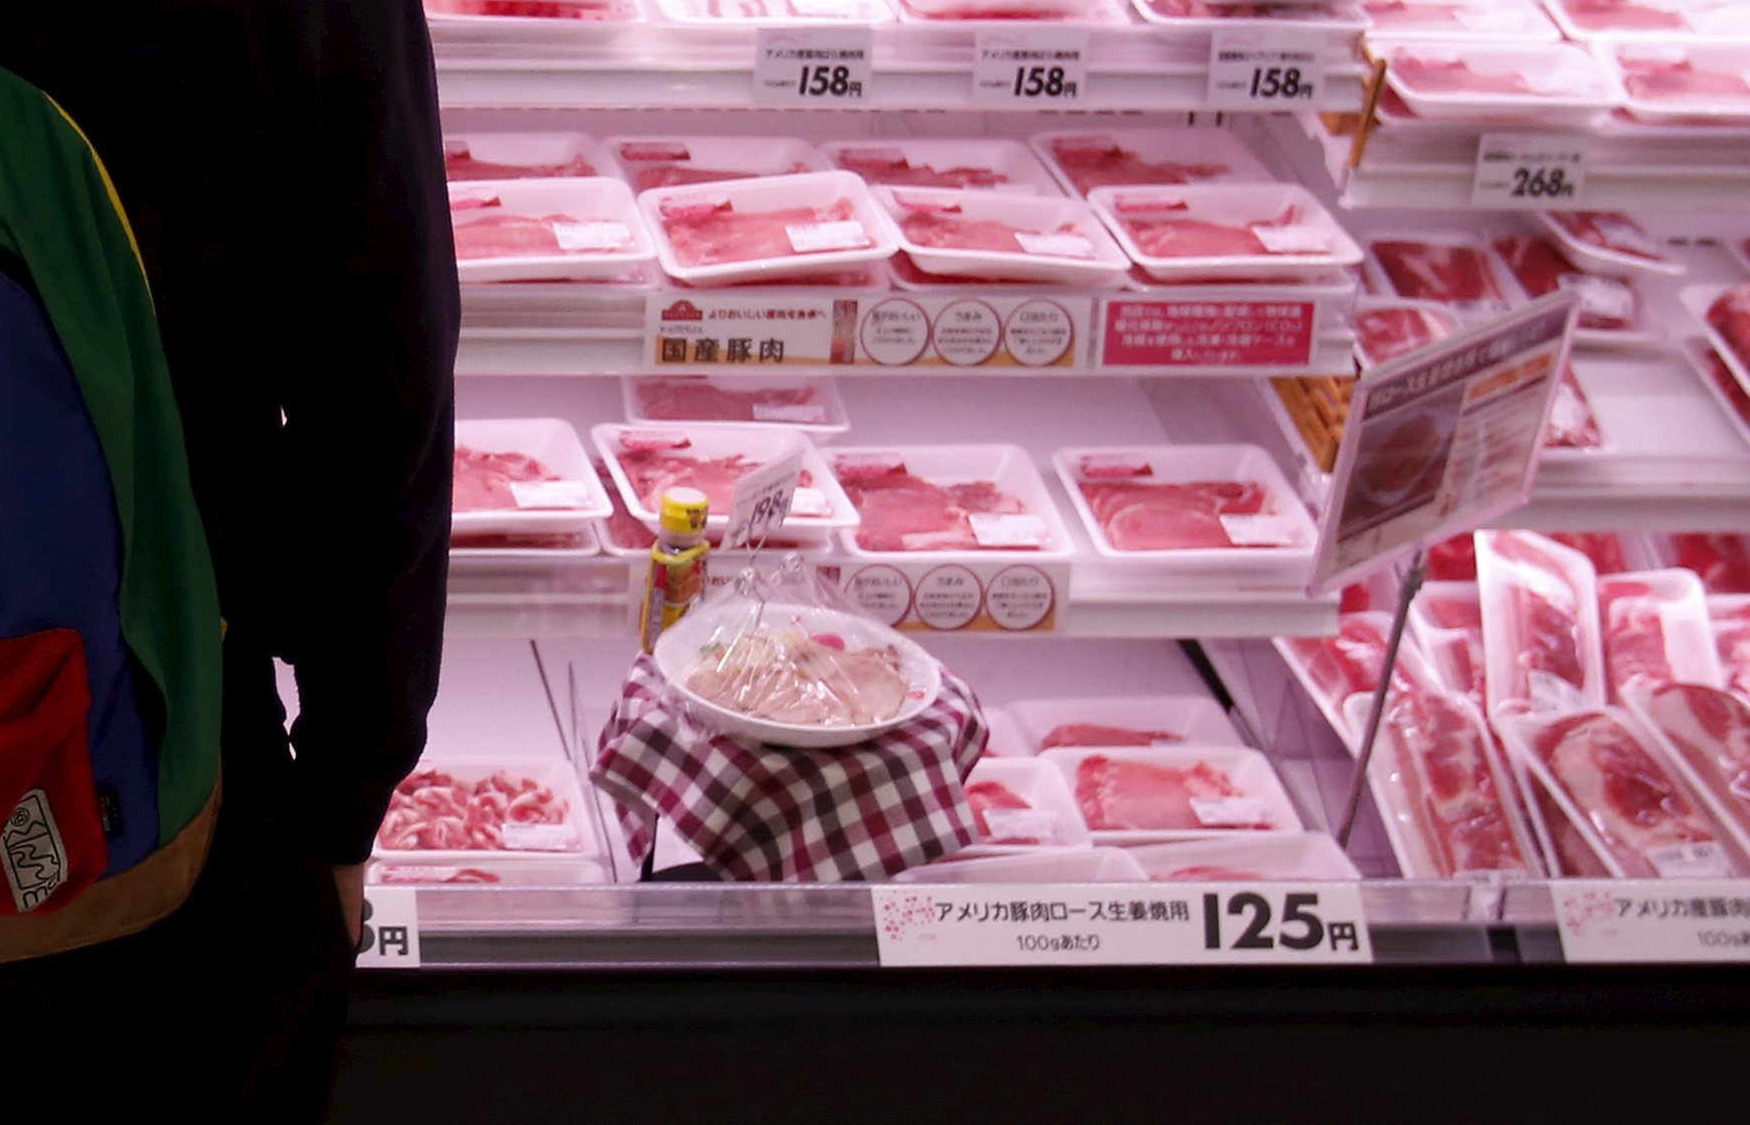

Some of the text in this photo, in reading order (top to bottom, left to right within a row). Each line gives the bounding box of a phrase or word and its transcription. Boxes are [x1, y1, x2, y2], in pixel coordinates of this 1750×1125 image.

[798, 65, 862, 98] 158円
[1014, 66, 1078, 99] 158円
[1250, 67, 1313, 100] 158円
[662, 338, 786, 363] 国産豚肉
[935, 900, 1189, 922] アメリカ豚肉ロース生姜焼用
[1202, 892, 1360, 951] 125円
[1016, 934, 1100, 952] 100gあたり
